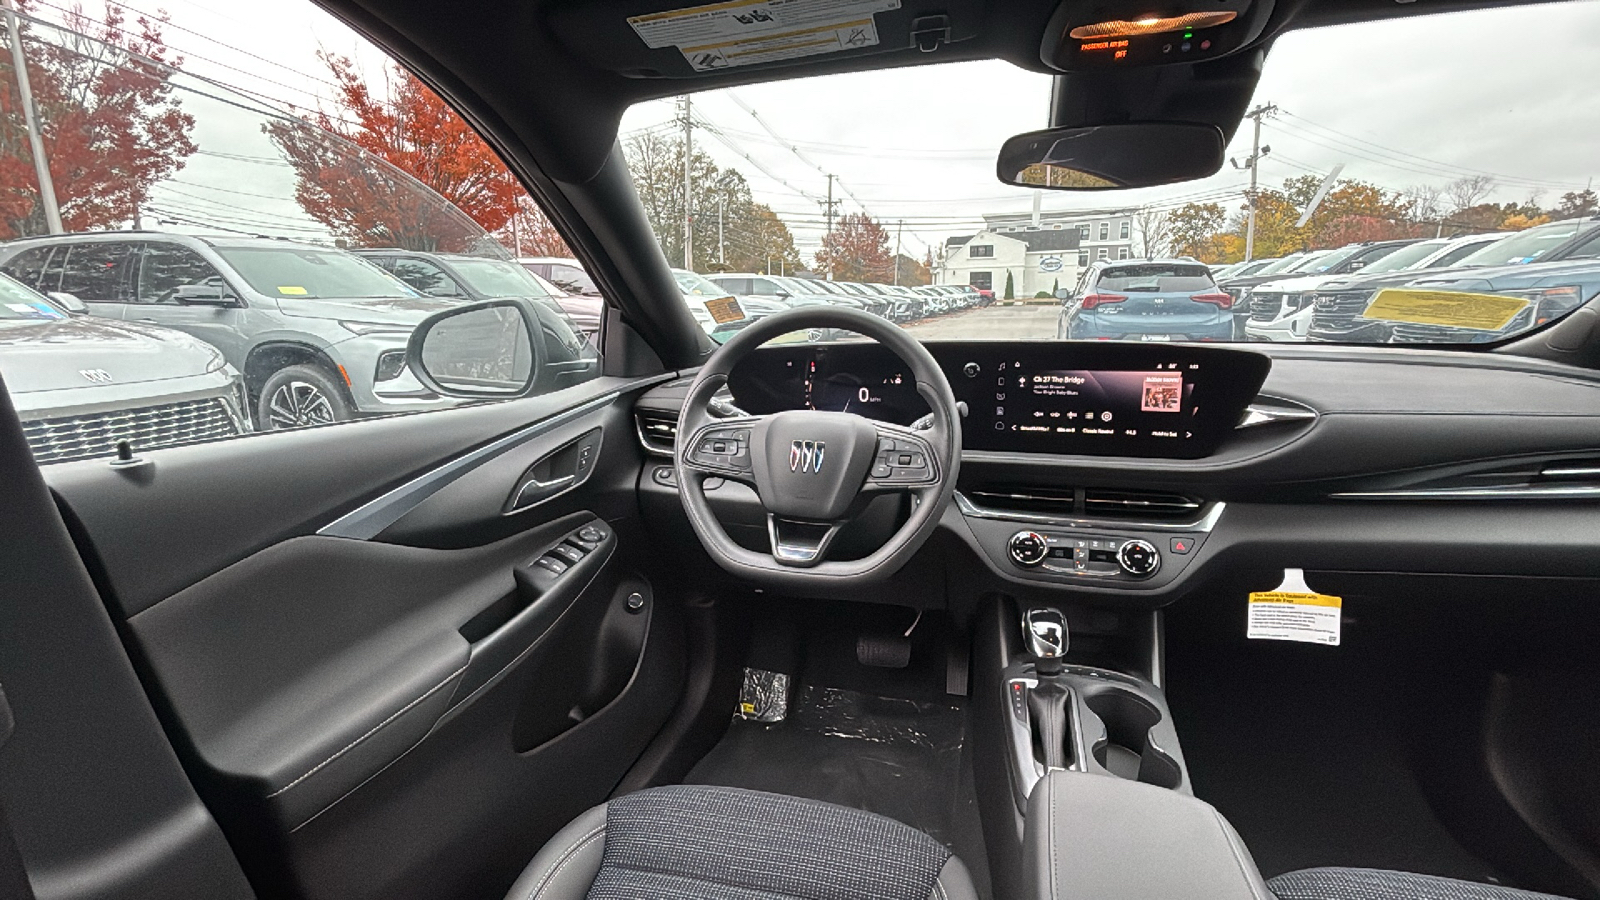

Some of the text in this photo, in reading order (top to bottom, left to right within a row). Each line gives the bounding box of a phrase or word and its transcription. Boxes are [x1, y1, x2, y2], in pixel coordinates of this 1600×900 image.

[1081, 42, 1108, 50] PASSENGER
[1115, 50, 1127, 58] OFF
[1064, 376, 1085, 384] Bridge
[859, 387, 869, 402] 0
